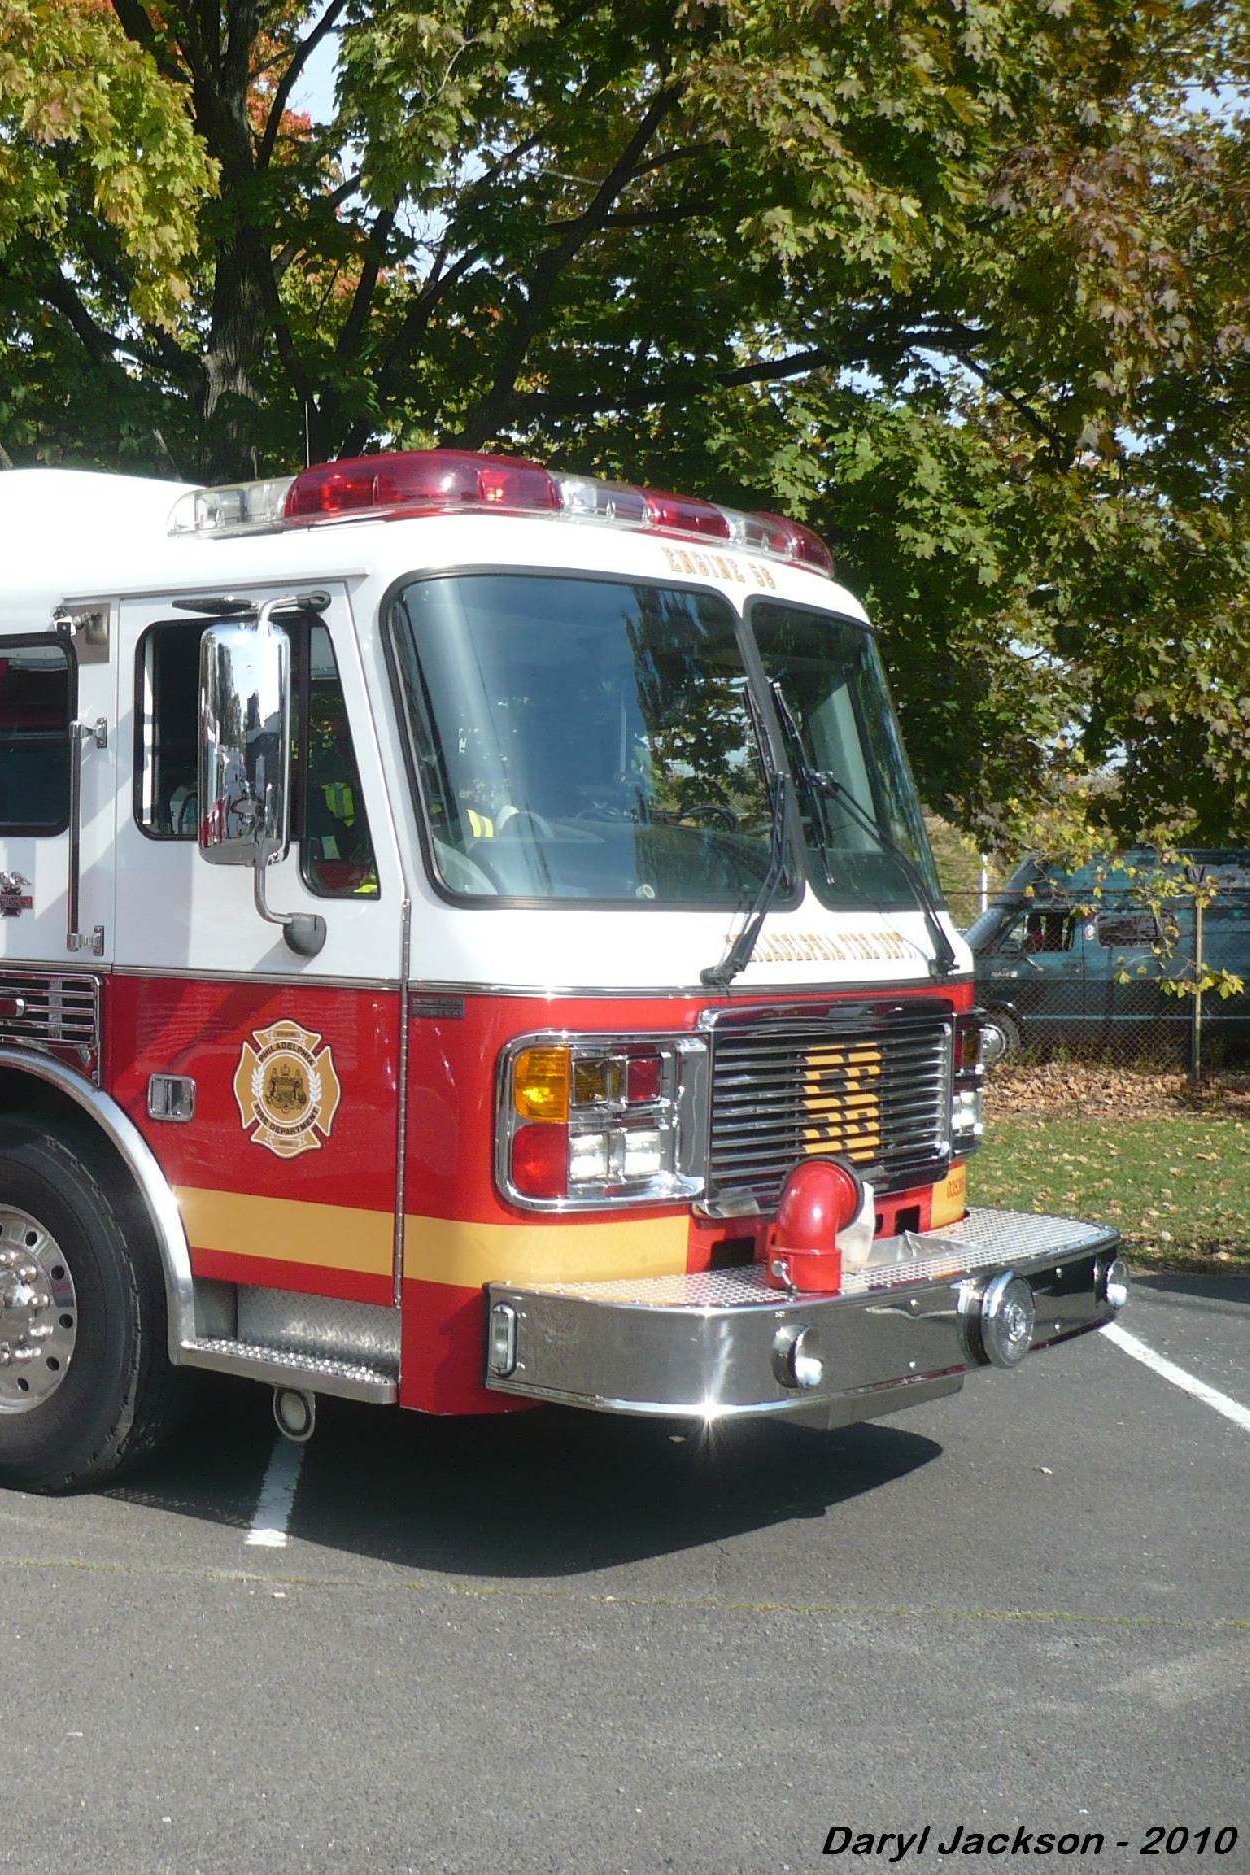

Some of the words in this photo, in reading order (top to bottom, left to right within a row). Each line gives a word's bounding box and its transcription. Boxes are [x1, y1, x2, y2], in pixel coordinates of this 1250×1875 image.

[661, 546, 745, 583] ENGINE
[748, 561, 777, 589] 56
[723, 933, 846, 963] PILADELPHIA
[802, 1042, 882, 1160] 56
[269, 1106, 319, 1135] DEPARTMENT
